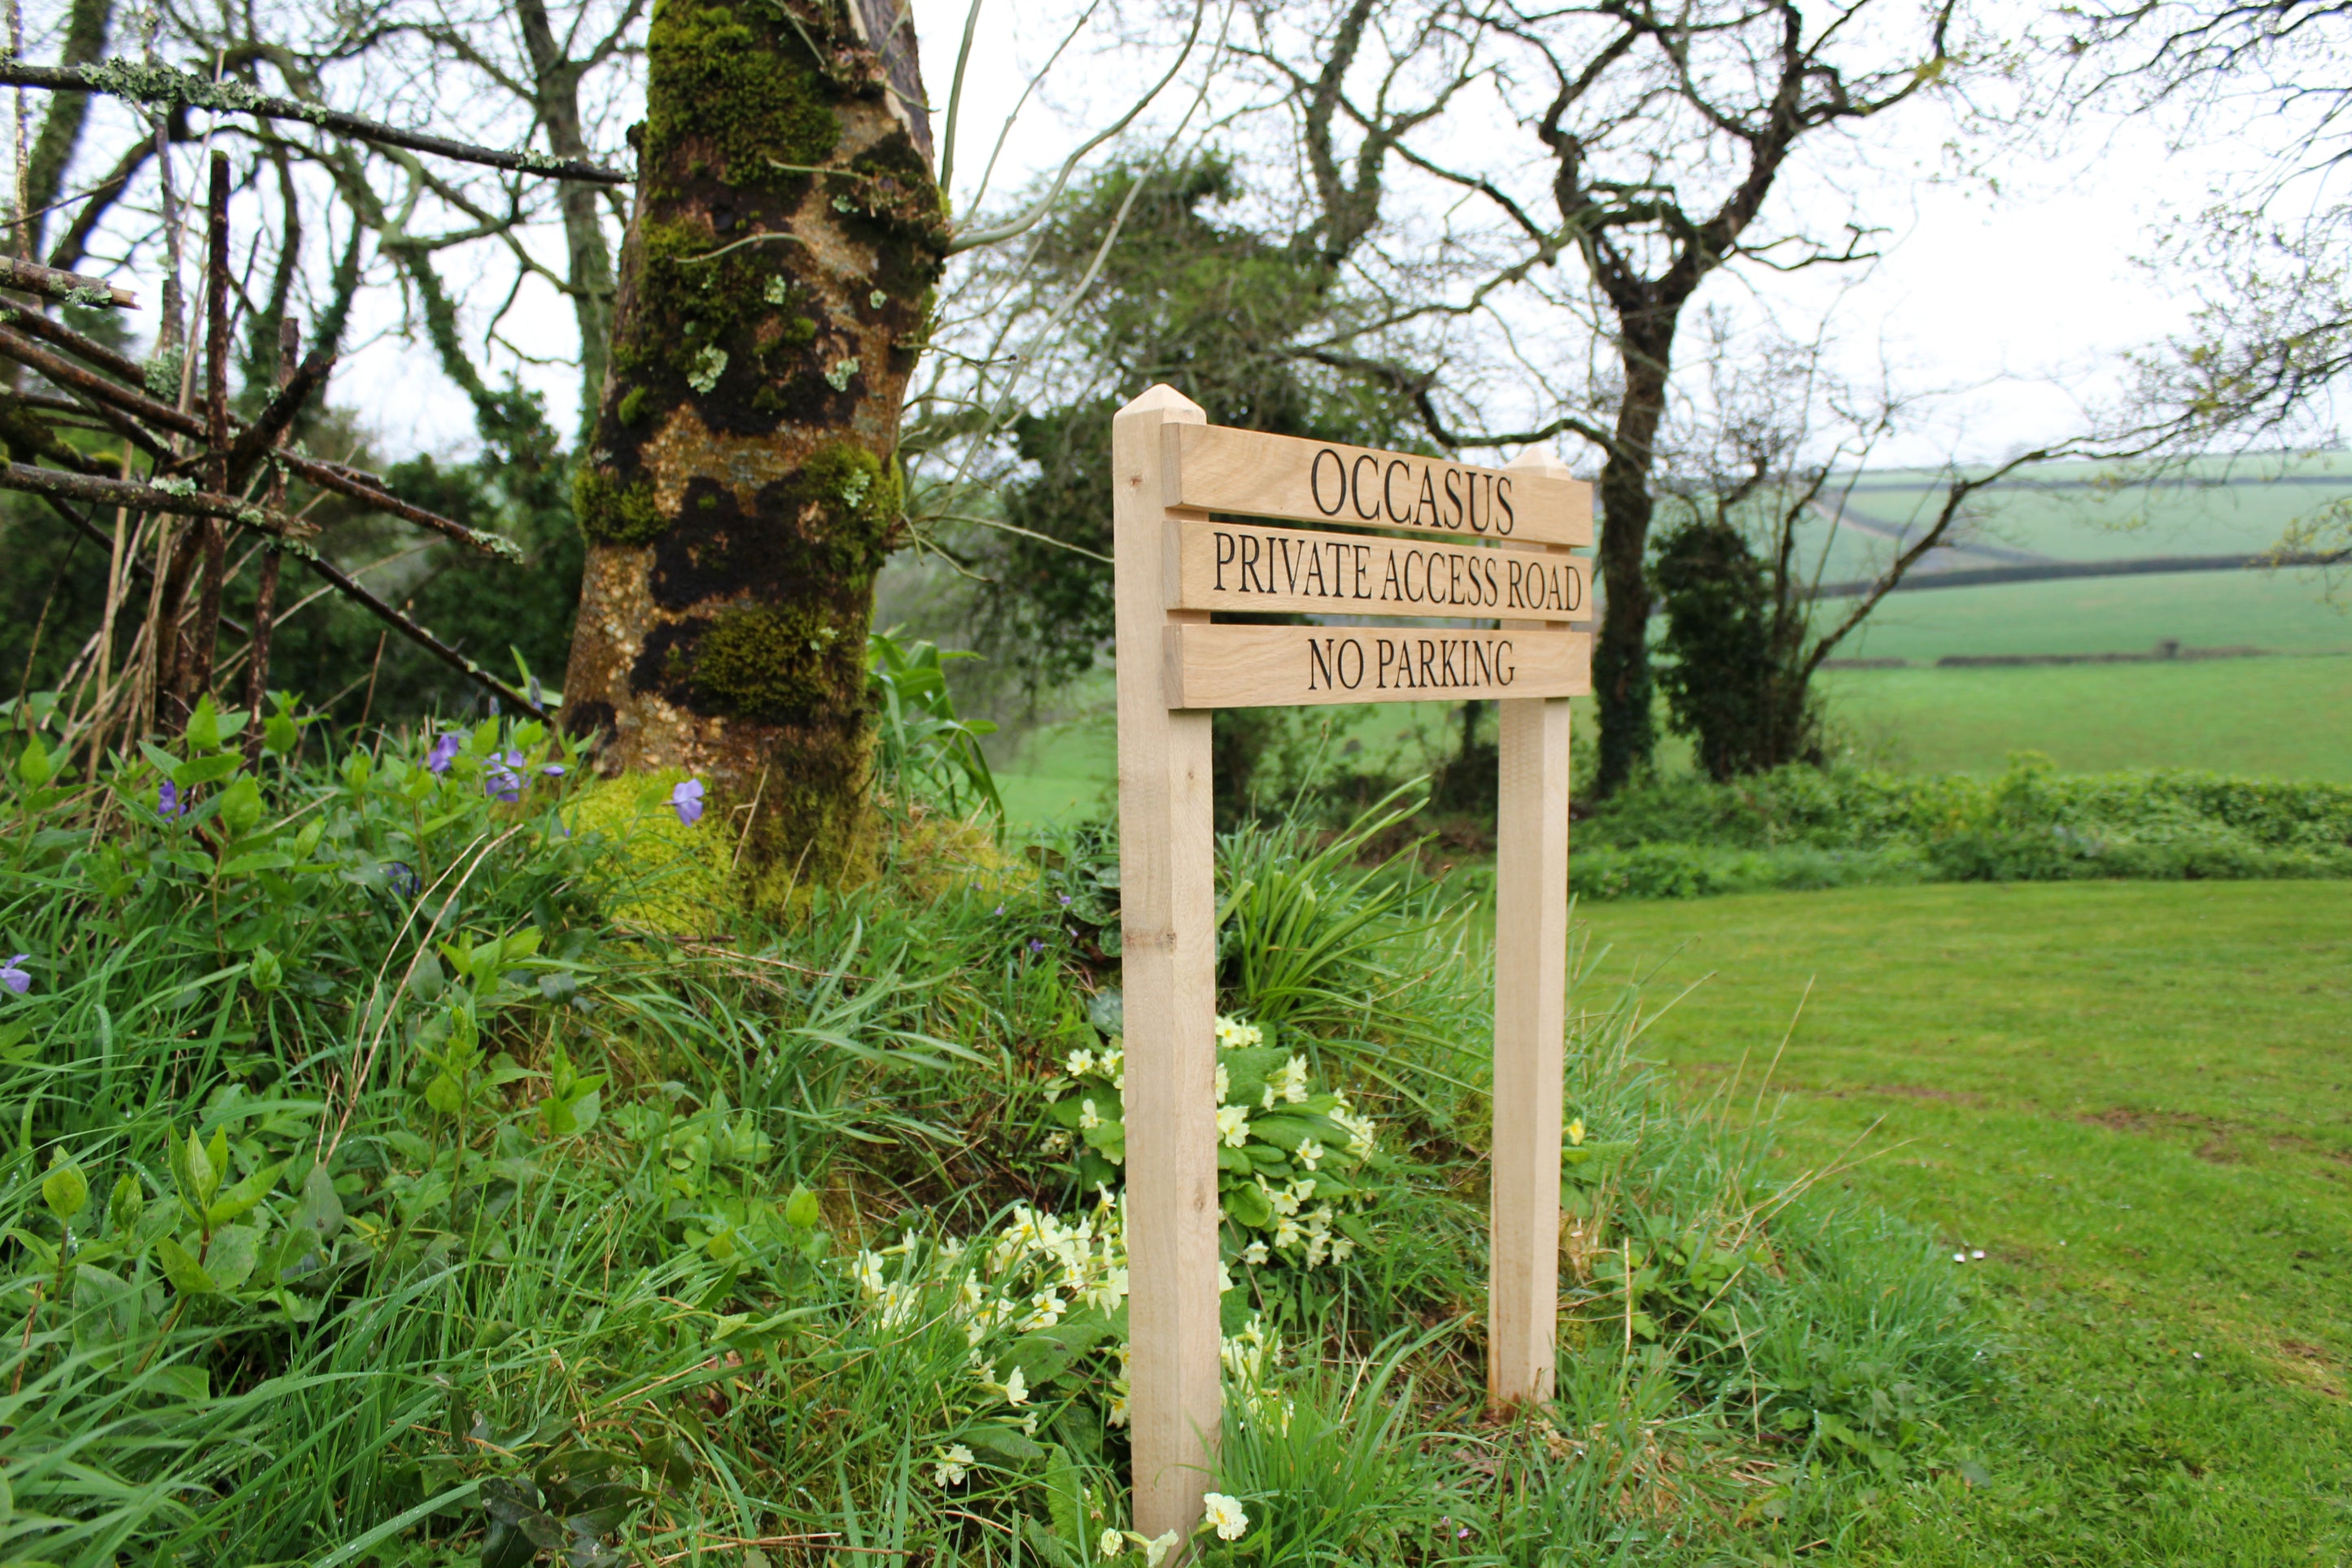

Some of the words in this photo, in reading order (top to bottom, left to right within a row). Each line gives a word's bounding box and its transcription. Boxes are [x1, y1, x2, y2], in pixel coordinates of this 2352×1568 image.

[1310, 448, 1515, 535] OCCASUS
[1213, 531, 1373, 600] PRIVATE
[1380, 548, 1499, 607] ACCESS
[1507, 560, 1582, 612] ROAD
[1308, 638, 1365, 691] NO
[1376, 638, 1516, 689] PARKING
